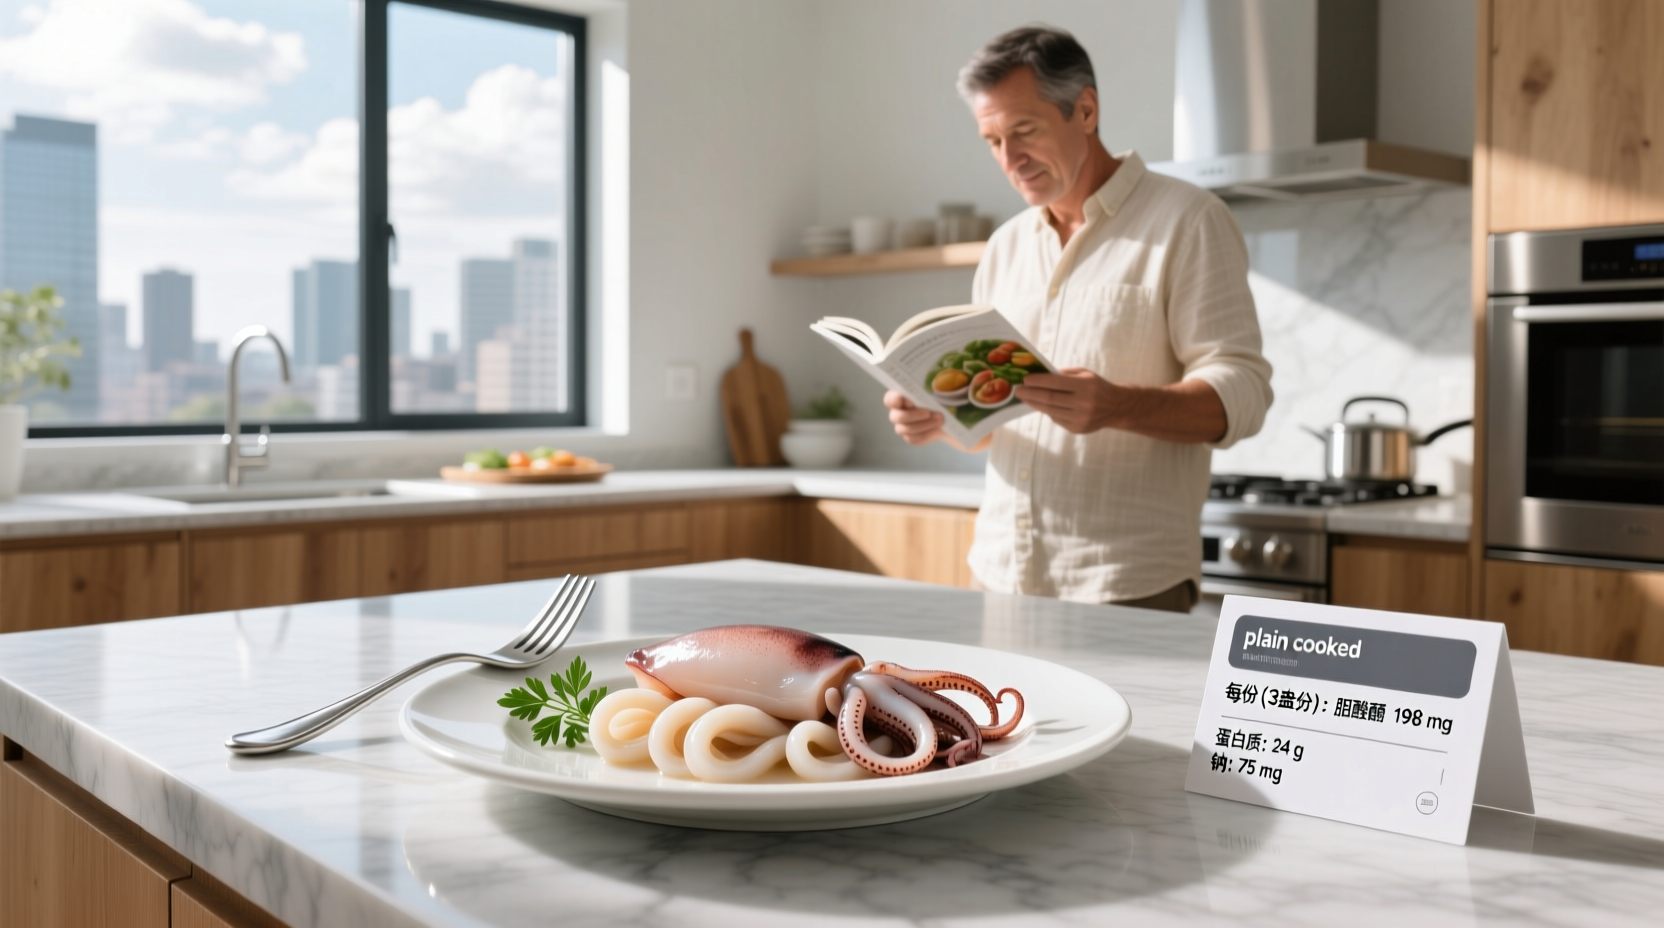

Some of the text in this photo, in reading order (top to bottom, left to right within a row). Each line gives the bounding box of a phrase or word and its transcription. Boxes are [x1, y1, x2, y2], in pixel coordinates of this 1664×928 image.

[1243, 627, 1362, 659] plain cooked
[1394, 707, 1423, 727] 198
[1426, 716, 1453, 735] mg
[1272, 738, 1291, 755] 24
[1293, 745, 1304, 762] g
[1238, 757, 1257, 775] 75
[1259, 765, 1283, 785] mg
